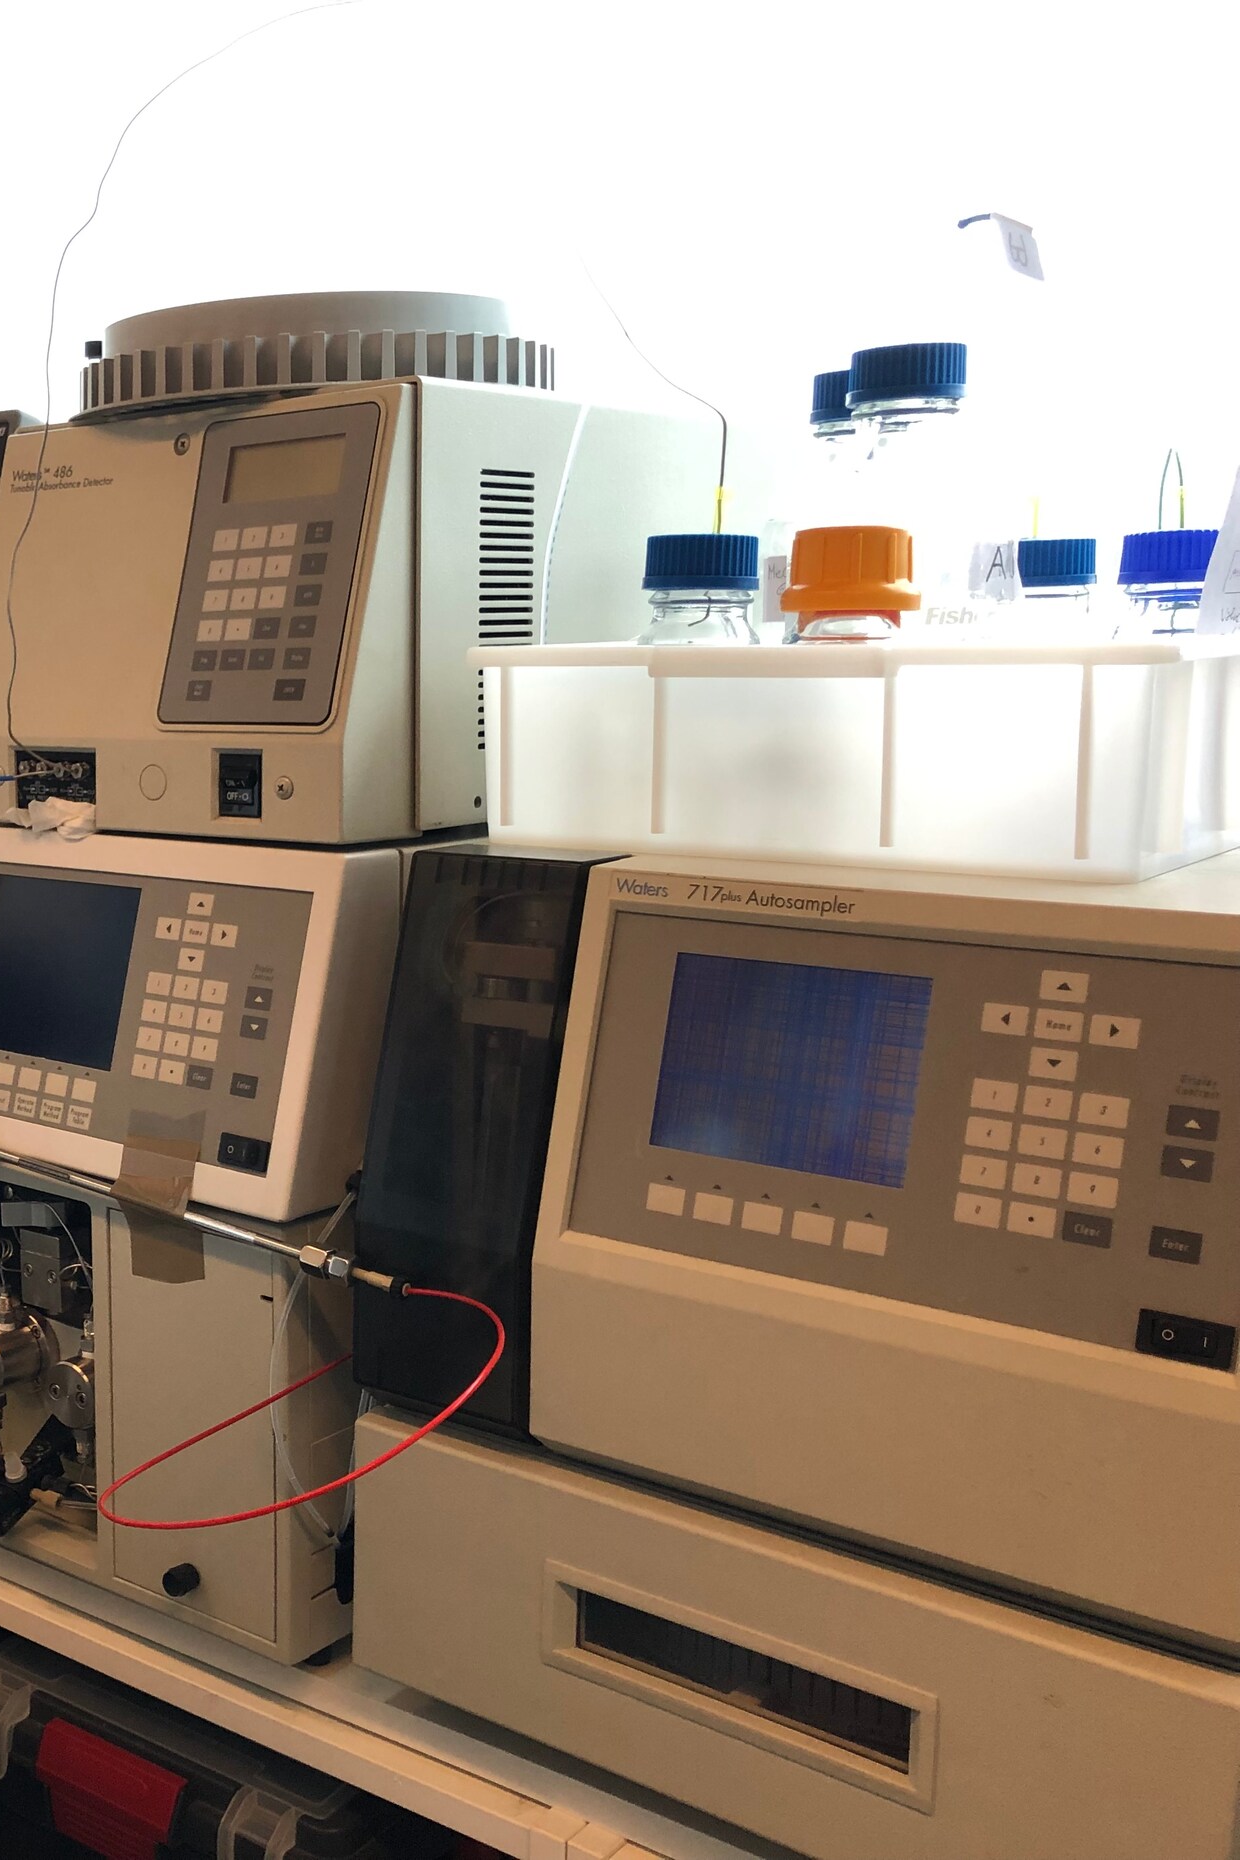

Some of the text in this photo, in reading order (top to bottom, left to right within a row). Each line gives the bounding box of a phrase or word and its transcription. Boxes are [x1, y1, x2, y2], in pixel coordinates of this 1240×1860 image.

[53, 465, 73, 478] 486
[38, 481, 81, 491] Absorbance
[83, 478, 114, 487] Detector
[616, 878, 669, 898] Waters
[745, 890, 856, 917] Autosampler
[1046, 1018, 1072, 1032] Home
[43, 1102, 62, 1111] Program
[1074, 1223, 1101, 1237] Clear
